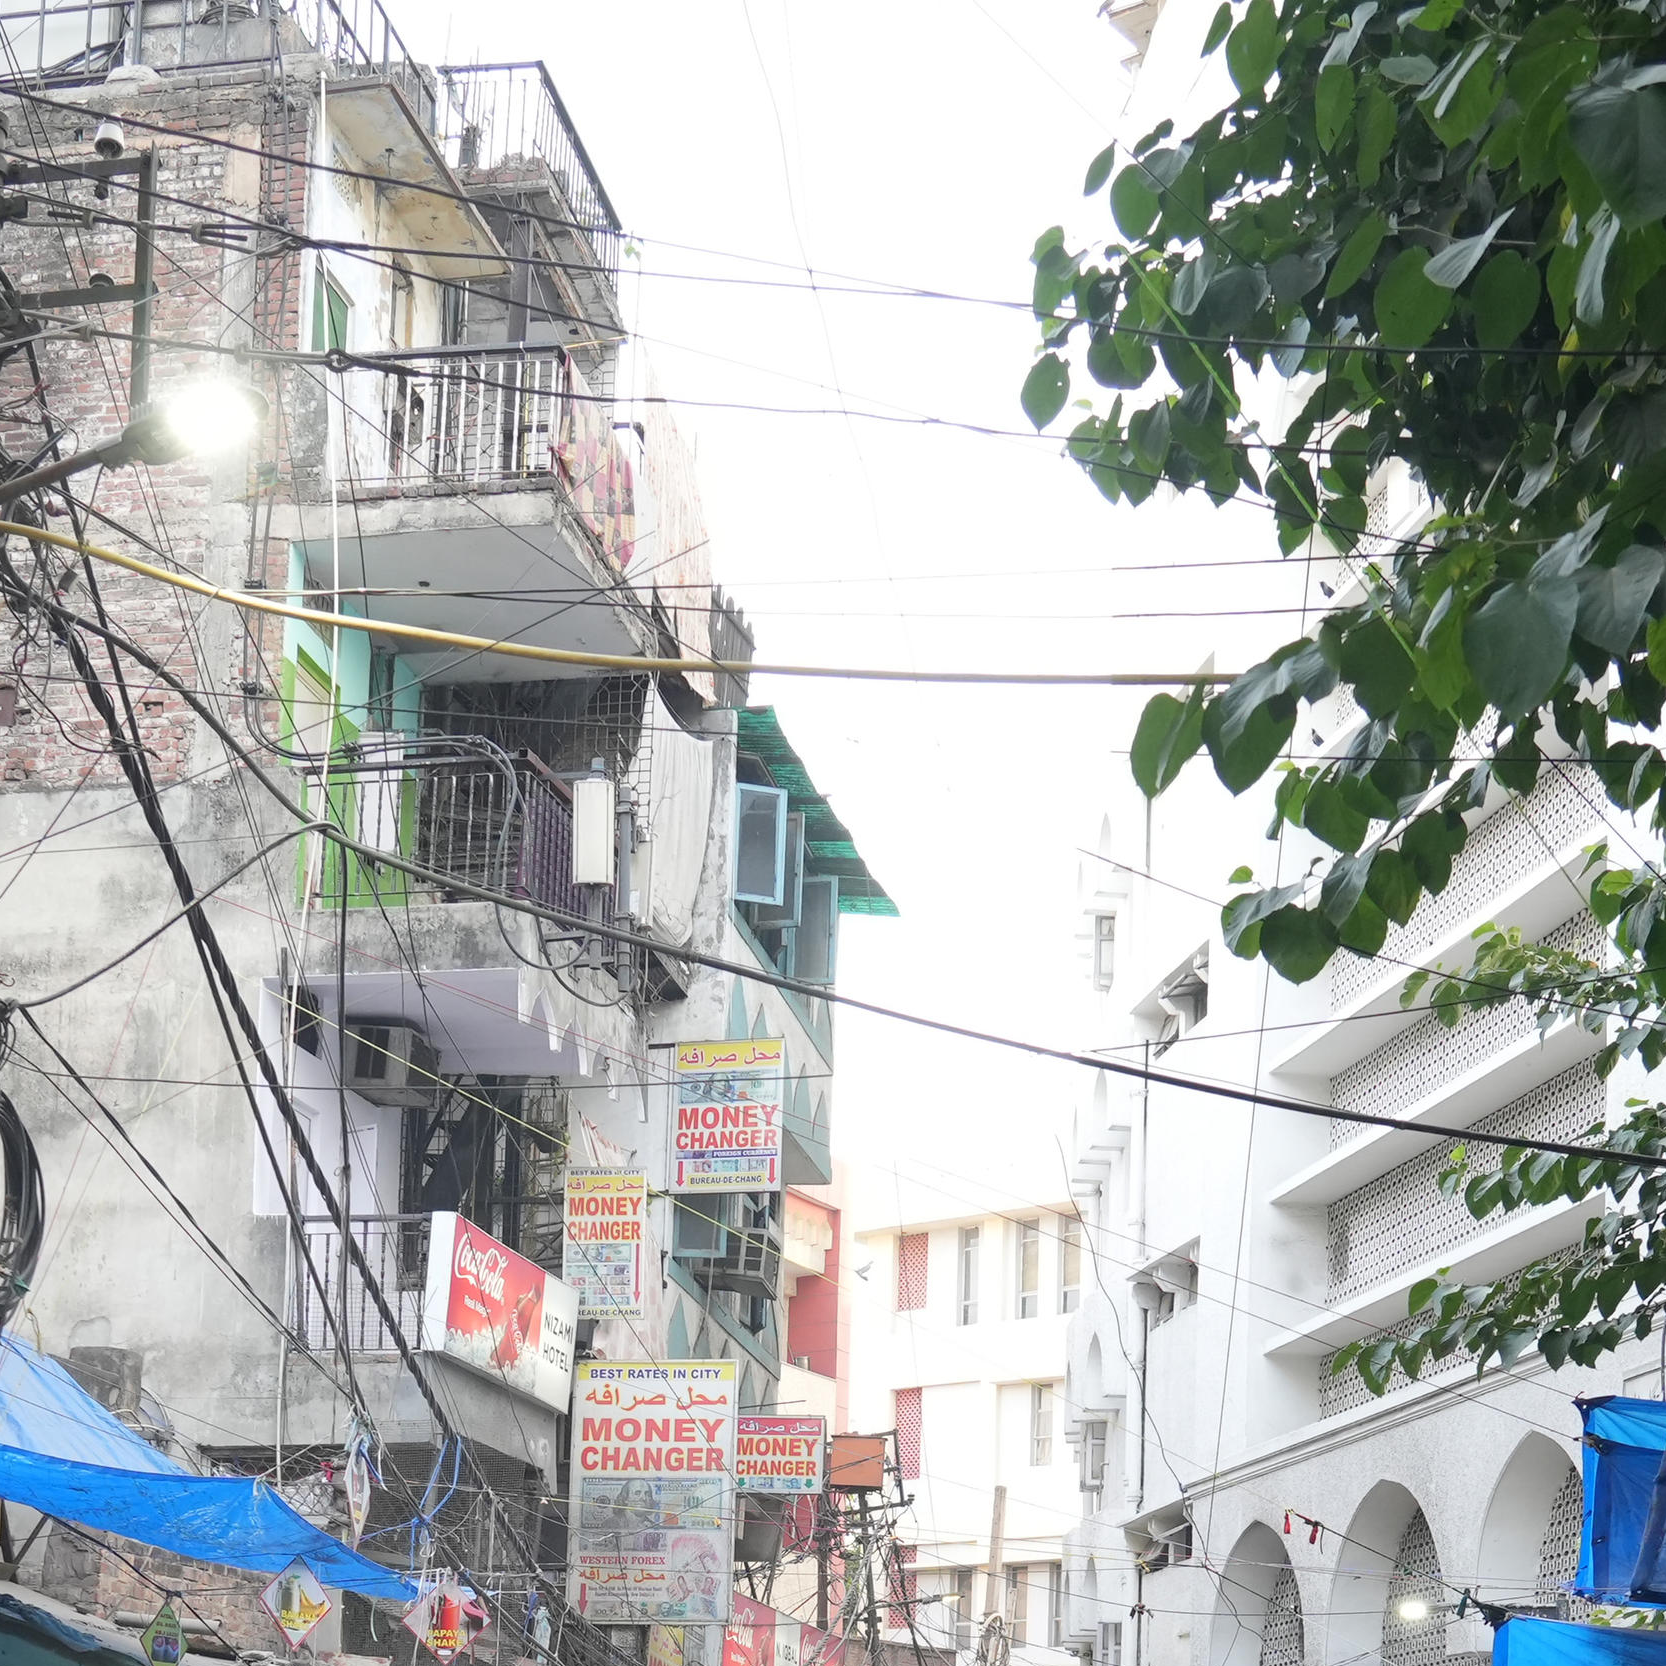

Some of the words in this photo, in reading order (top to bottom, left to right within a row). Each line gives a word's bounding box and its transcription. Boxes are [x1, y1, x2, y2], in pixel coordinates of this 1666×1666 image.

[678, 1104, 779, 1131] MONEY
[676, 1129, 778, 1150] CHANGER
[568, 1196, 643, 1216] MONEY
[567, 1221, 641, 1241] CHANGER
[543, 1311, 574, 1345] NIZAMI
[542, 1343, 569, 1373] HOTEL
[590, 1369, 624, 1379] BEST
[627, 1369, 669, 1379] RATES
[673, 1369, 687, 1379] IN
[691, 1369, 721, 1379] CITY
[582, 1418, 726, 1443] MONEY
[737, 1438, 818, 1457] MONEY
[580, 1446, 725, 1472] CHANGER
[735, 1460, 817, 1477] CHANGER
[580, 1556, 629, 1565] WESTERN
[631, 1556, 666, 1565] FOREX
